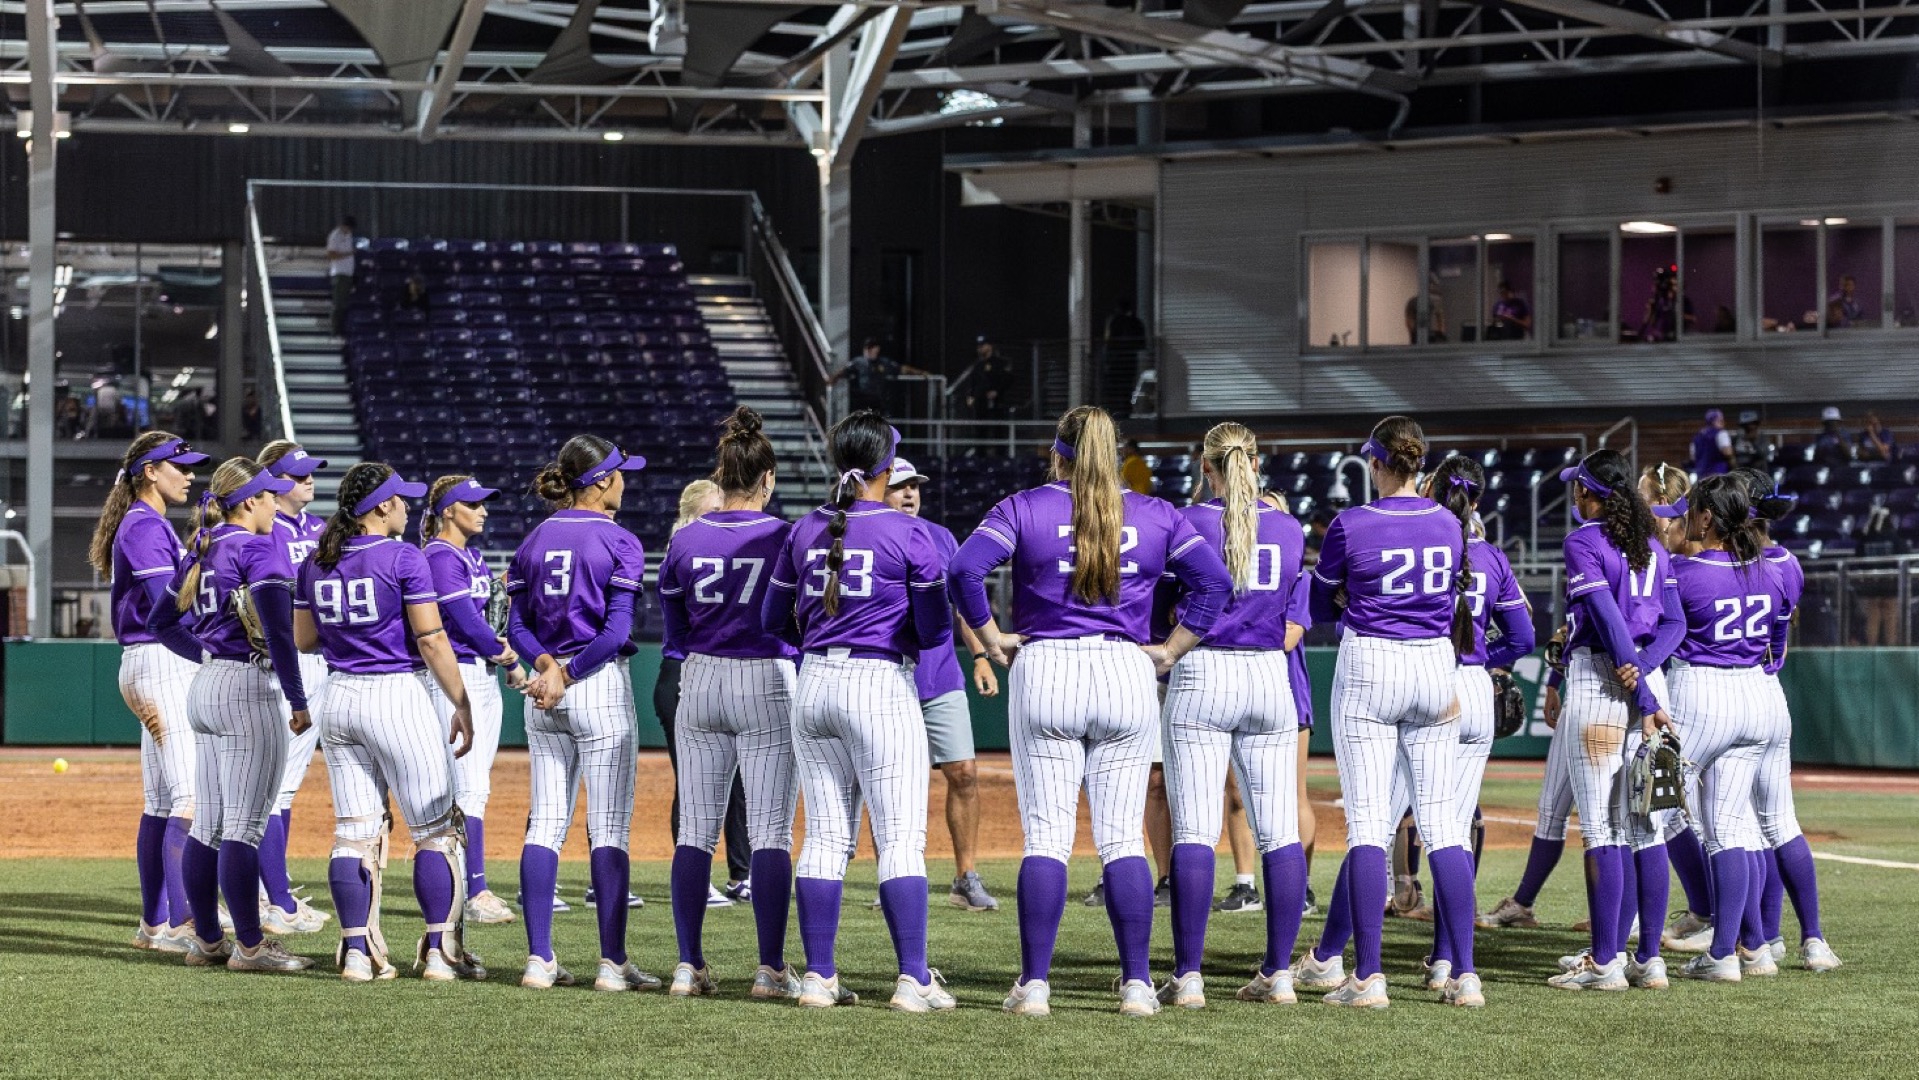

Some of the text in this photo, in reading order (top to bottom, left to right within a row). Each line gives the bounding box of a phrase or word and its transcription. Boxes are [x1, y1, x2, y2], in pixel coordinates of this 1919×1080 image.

[286, 540, 319, 564] GC
[544, 550, 572, 596] 3
[806, 549, 874, 597] 33
[1245, 544, 1281, 591] 0
[1381, 546, 1452, 594] 28
[314, 577, 378, 624] 99
[692, 557, 765, 604] 27
[1714, 594, 1772, 641] 22
